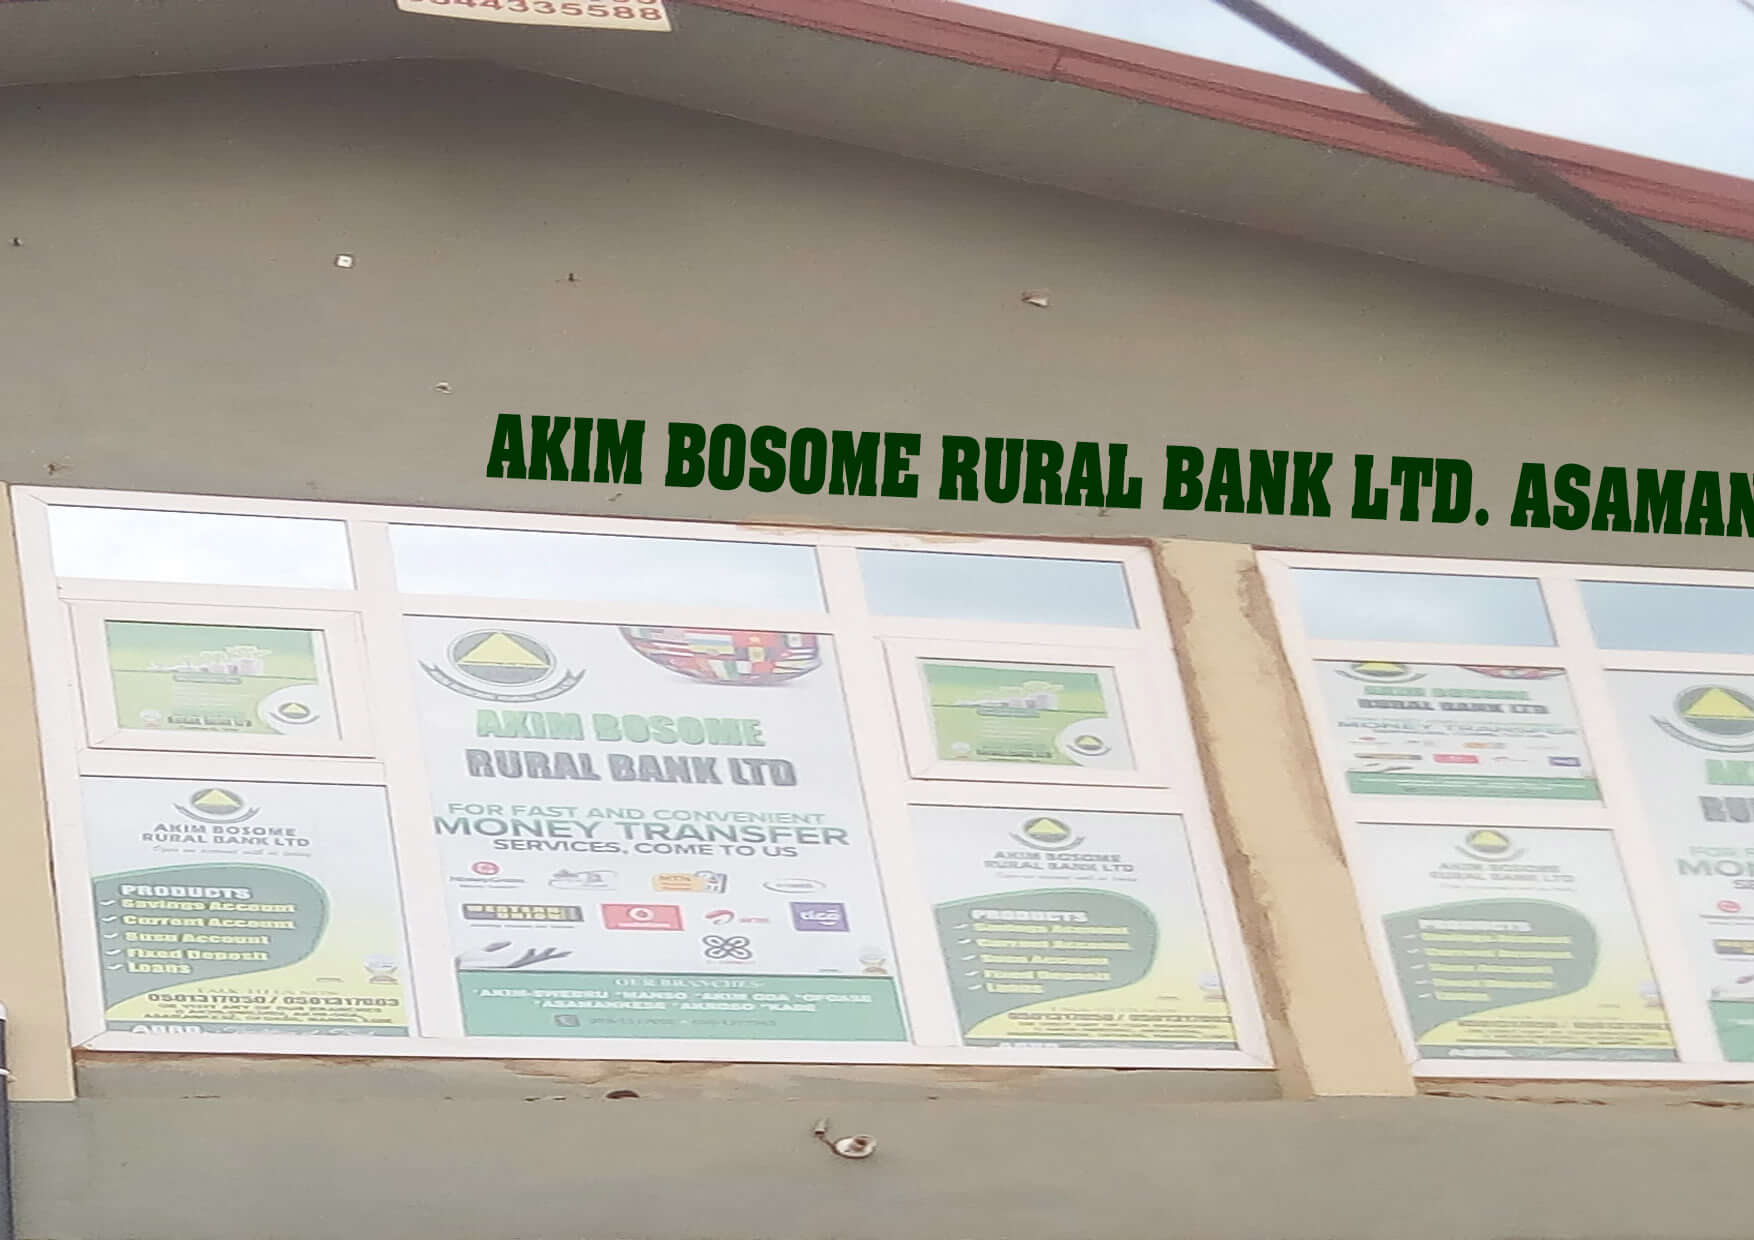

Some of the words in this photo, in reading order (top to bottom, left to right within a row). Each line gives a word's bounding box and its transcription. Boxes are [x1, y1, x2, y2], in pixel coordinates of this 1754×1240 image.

[476, 709, 585, 741] AKIM
[592, 713, 767, 747] BOSOME
[465, 749, 603, 781] RURAL
[607, 753, 723, 785] BANK
[727, 757, 798, 787] LTD
[448, 802, 504, 817] FOR
[511, 804, 579, 819] FAST
[586, 807, 646, 821] AND
[653, 808, 826, 826] CONVENIENT
[154, 823, 207, 834] AKIM
[212, 825, 297, 837] BOSOME
[433, 815, 603, 840] MONEY
[615, 821, 852, 847] TRANSFER
[142, 833, 208, 844] RURAL
[213, 835, 269, 846] BANK
[274, 837, 311, 848] LTD
[633, 842, 715, 857] COME
[718, 844, 765, 858] TO
[773, 846, 800, 859] US
[120, 884, 252, 899] PRODUCTS
